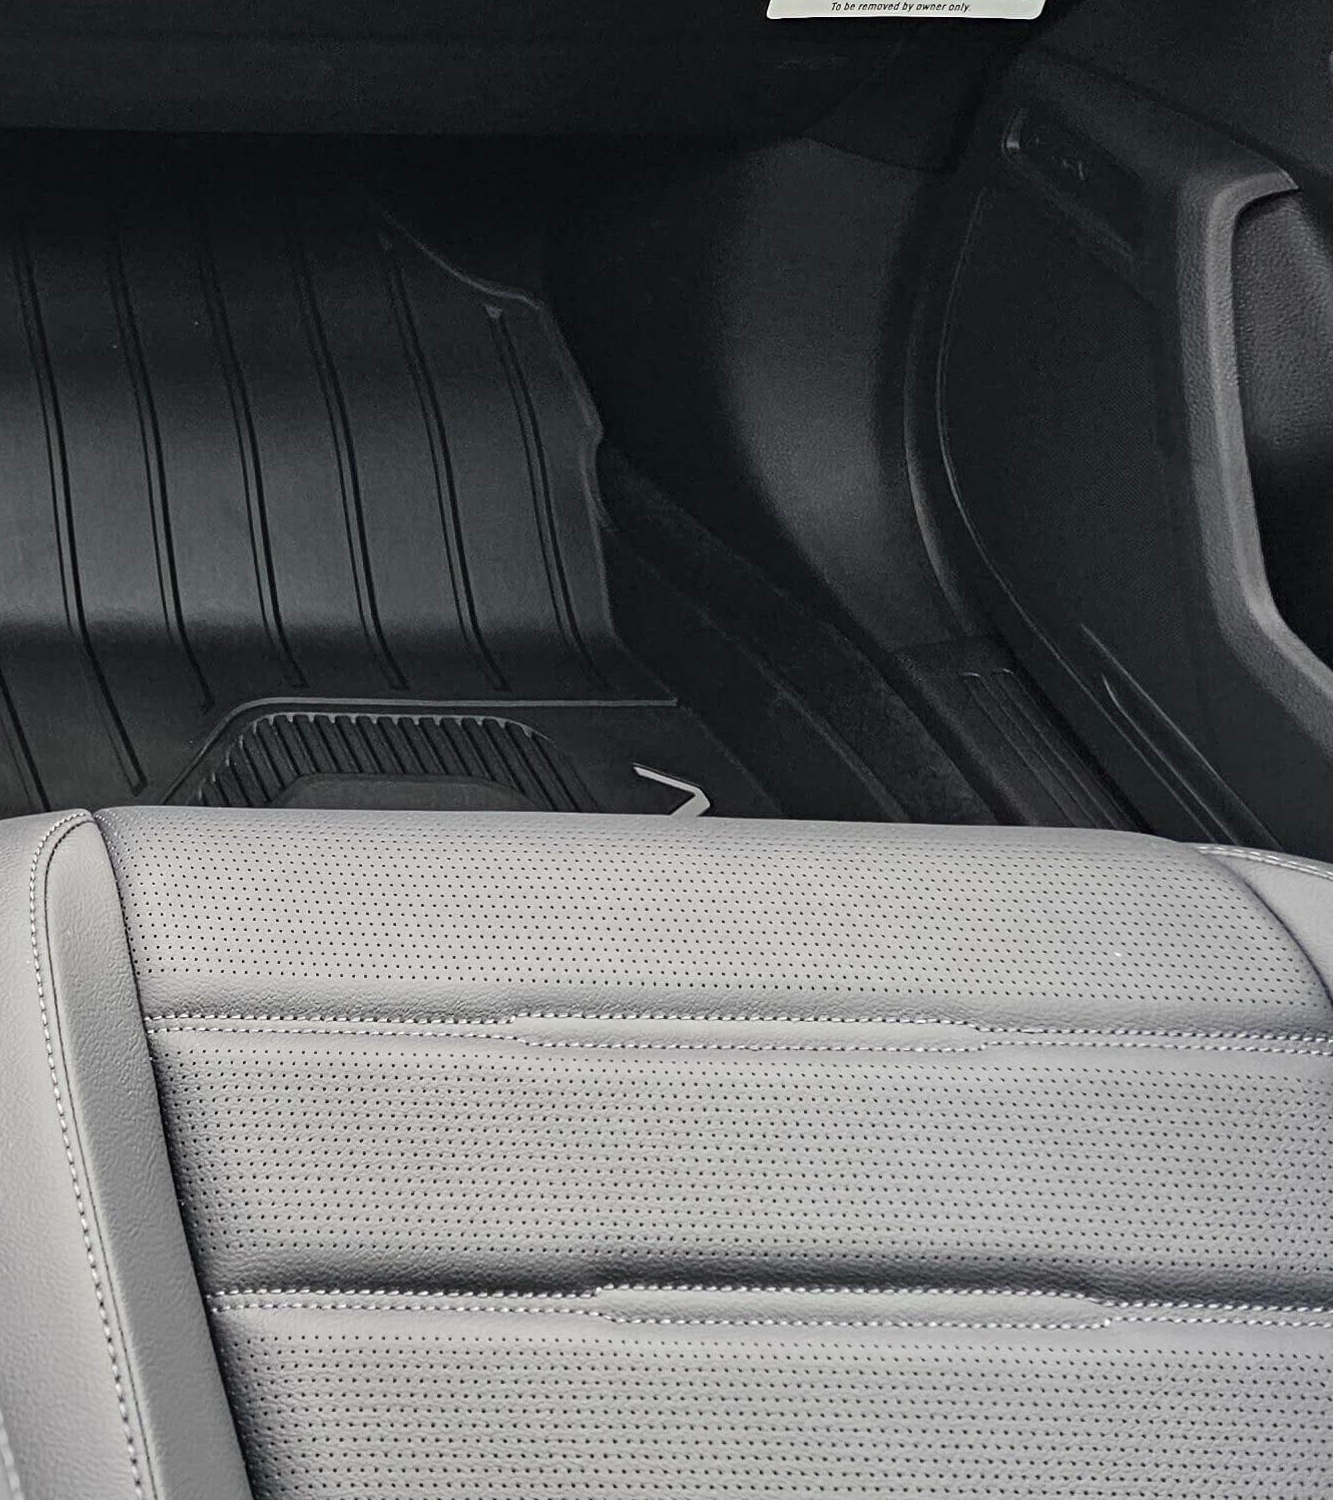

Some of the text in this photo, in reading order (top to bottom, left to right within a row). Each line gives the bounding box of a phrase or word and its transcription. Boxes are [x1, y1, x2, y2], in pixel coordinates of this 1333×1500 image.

[831, 1, 972, 14] To be removed by owner only.
